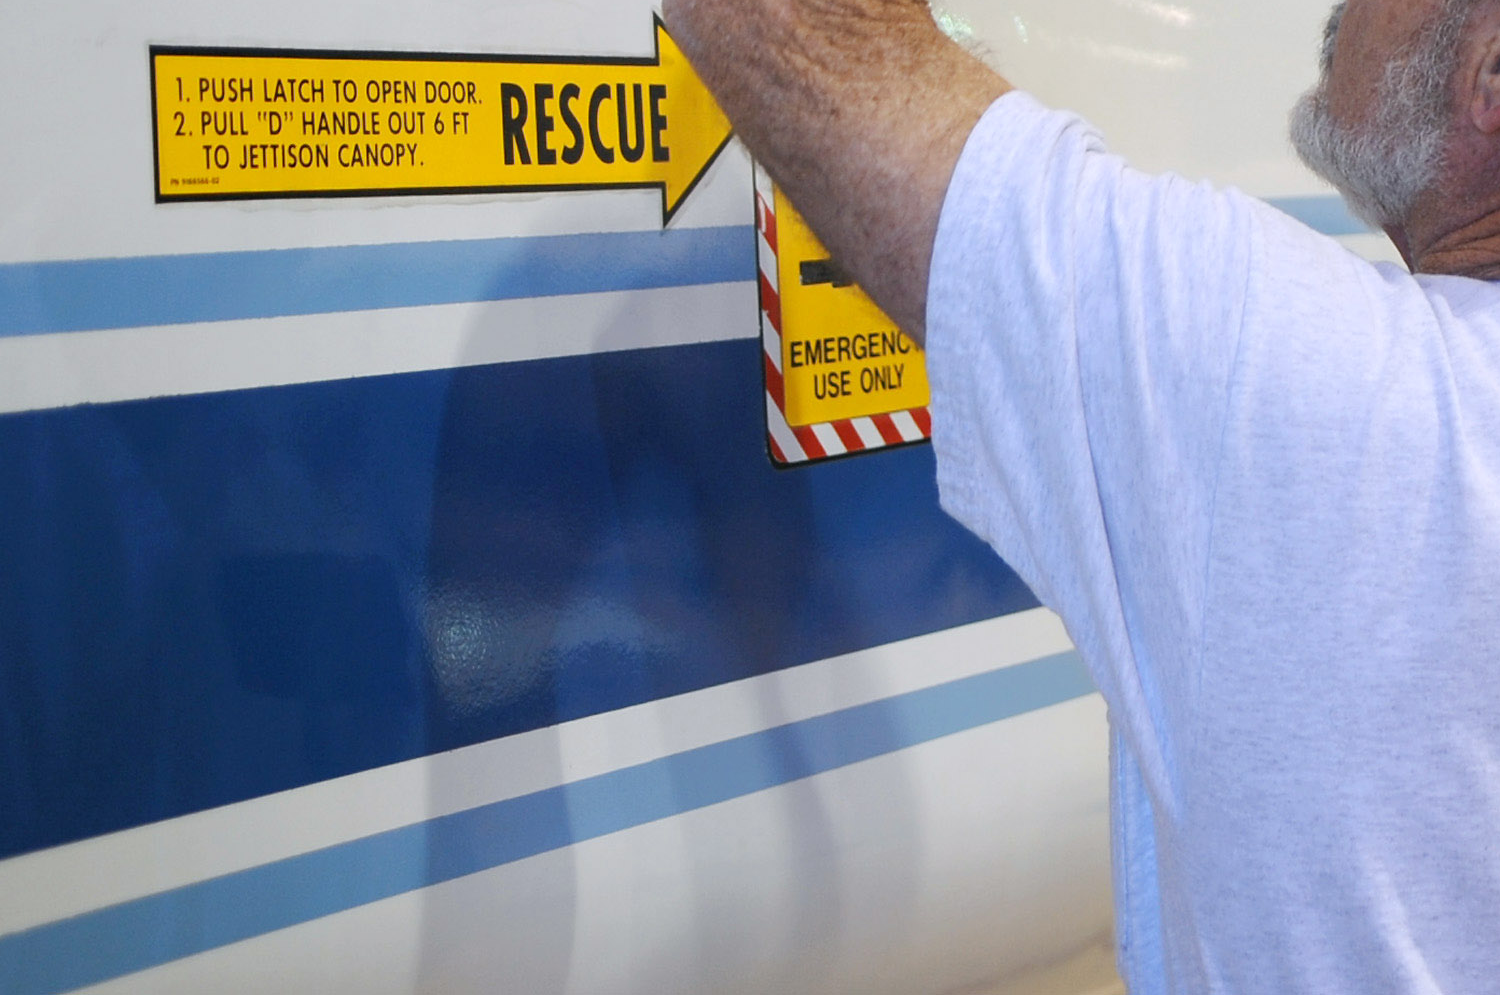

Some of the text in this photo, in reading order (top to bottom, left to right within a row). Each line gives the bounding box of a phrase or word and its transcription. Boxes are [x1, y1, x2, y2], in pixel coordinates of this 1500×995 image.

[176, 77, 483, 104] 1. PUSH LATCH TO OPEN DOOR.
[173, 111, 193, 136] 2.
[201, 111, 249, 135] PULL
[302, 111, 380, 136] HANDLE
[388, 111, 426, 135] OUT
[434, 111, 445, 135] 6
[453, 112, 470, 135] FT
[500, 82, 670, 166] RESCUE
[203, 143, 424, 170] TO JETTISON CANOPY.
[790, 330, 920, 368] EMERGENC
[814, 363, 905, 400] USE ONLY
